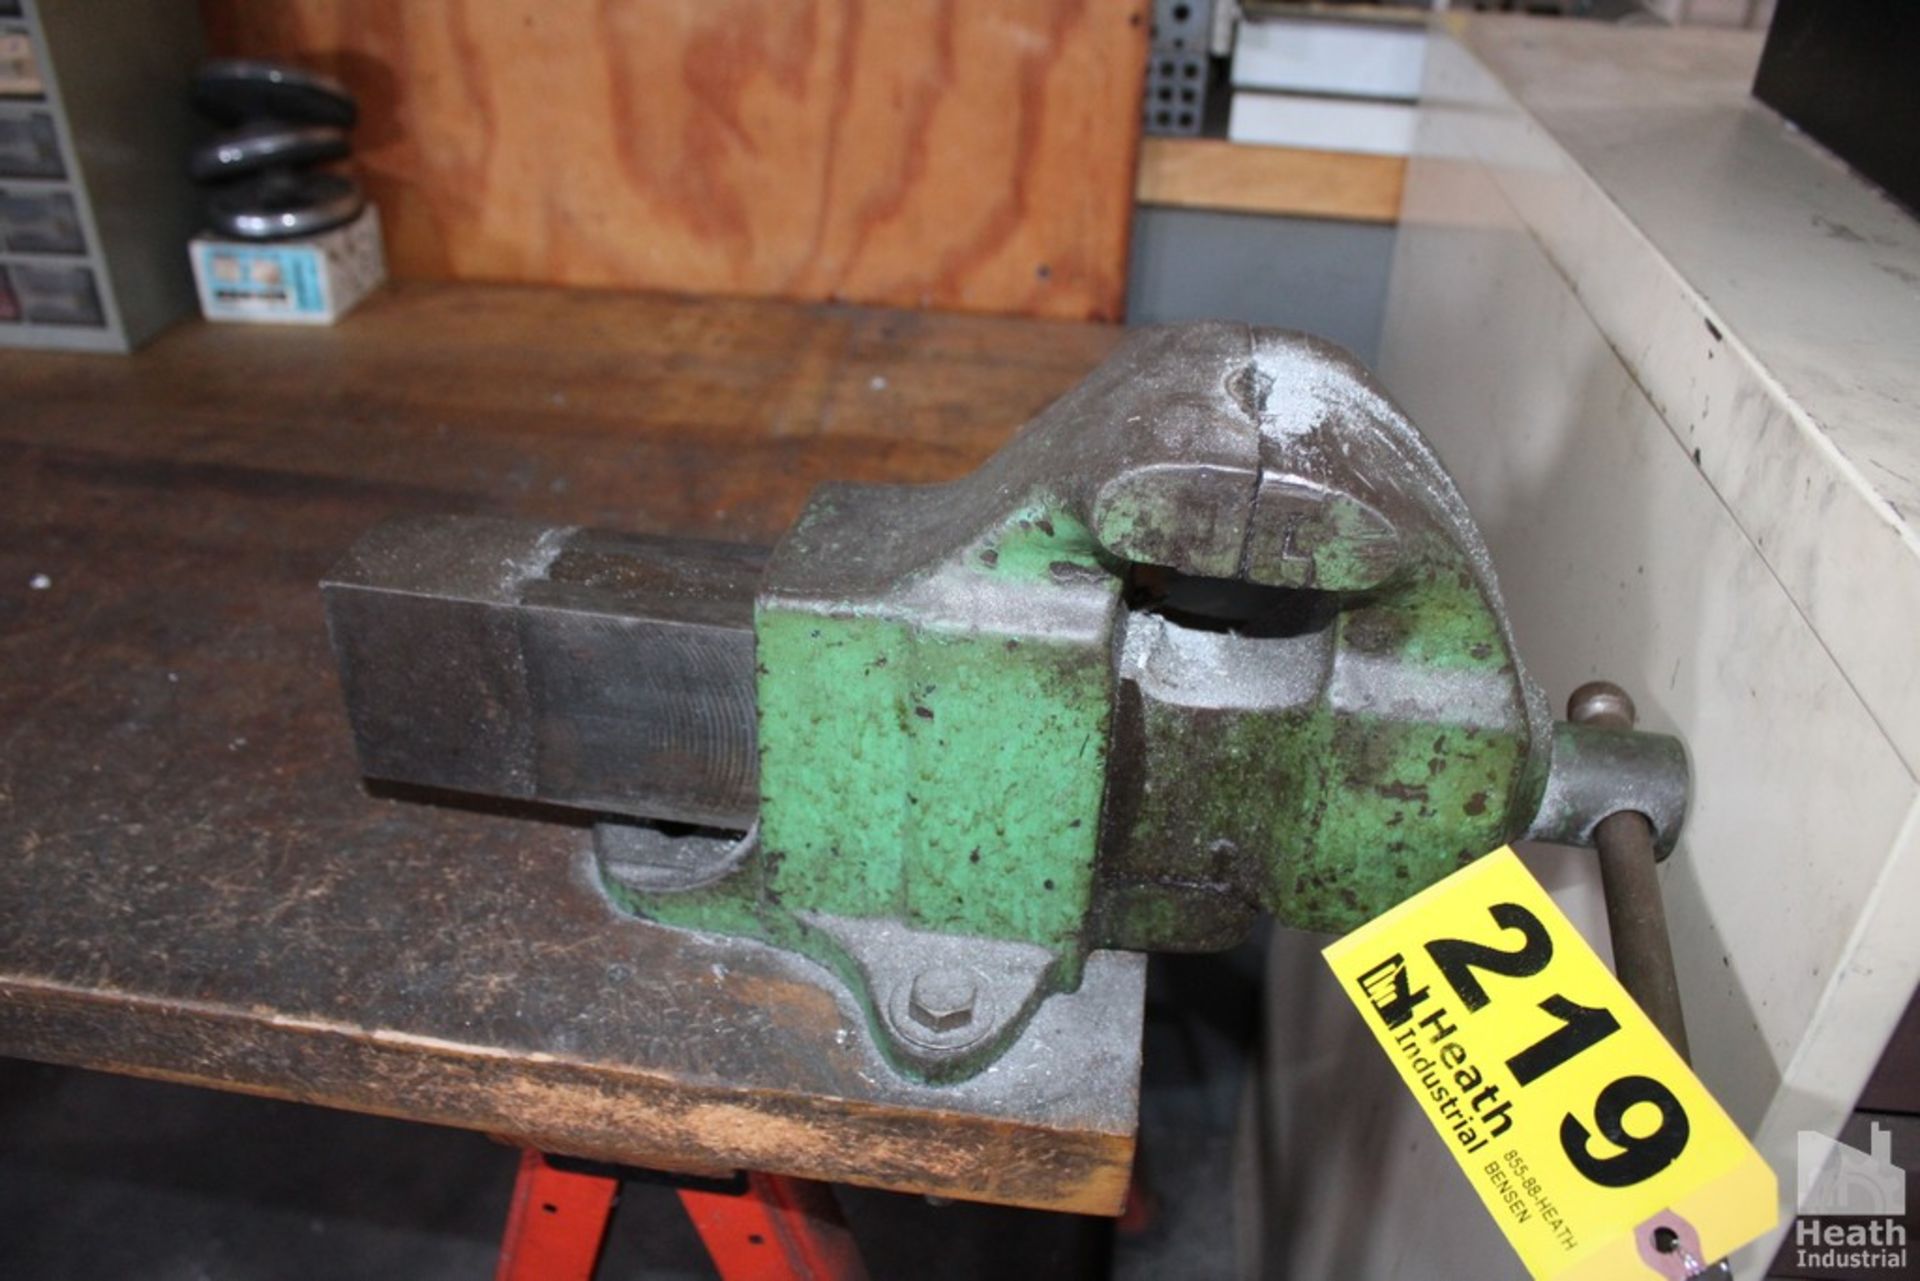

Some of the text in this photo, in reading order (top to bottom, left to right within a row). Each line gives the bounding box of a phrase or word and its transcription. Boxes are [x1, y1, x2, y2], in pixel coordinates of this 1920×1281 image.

[1395, 1027, 1489, 1154] Industrial
[1418, 1008, 1514, 1139] Heath
[1423, 902, 1690, 1188] 219
[1484, 1161, 1533, 1224] BENSEN
[1503, 1149, 1579, 1252] 855-88-HEATH
